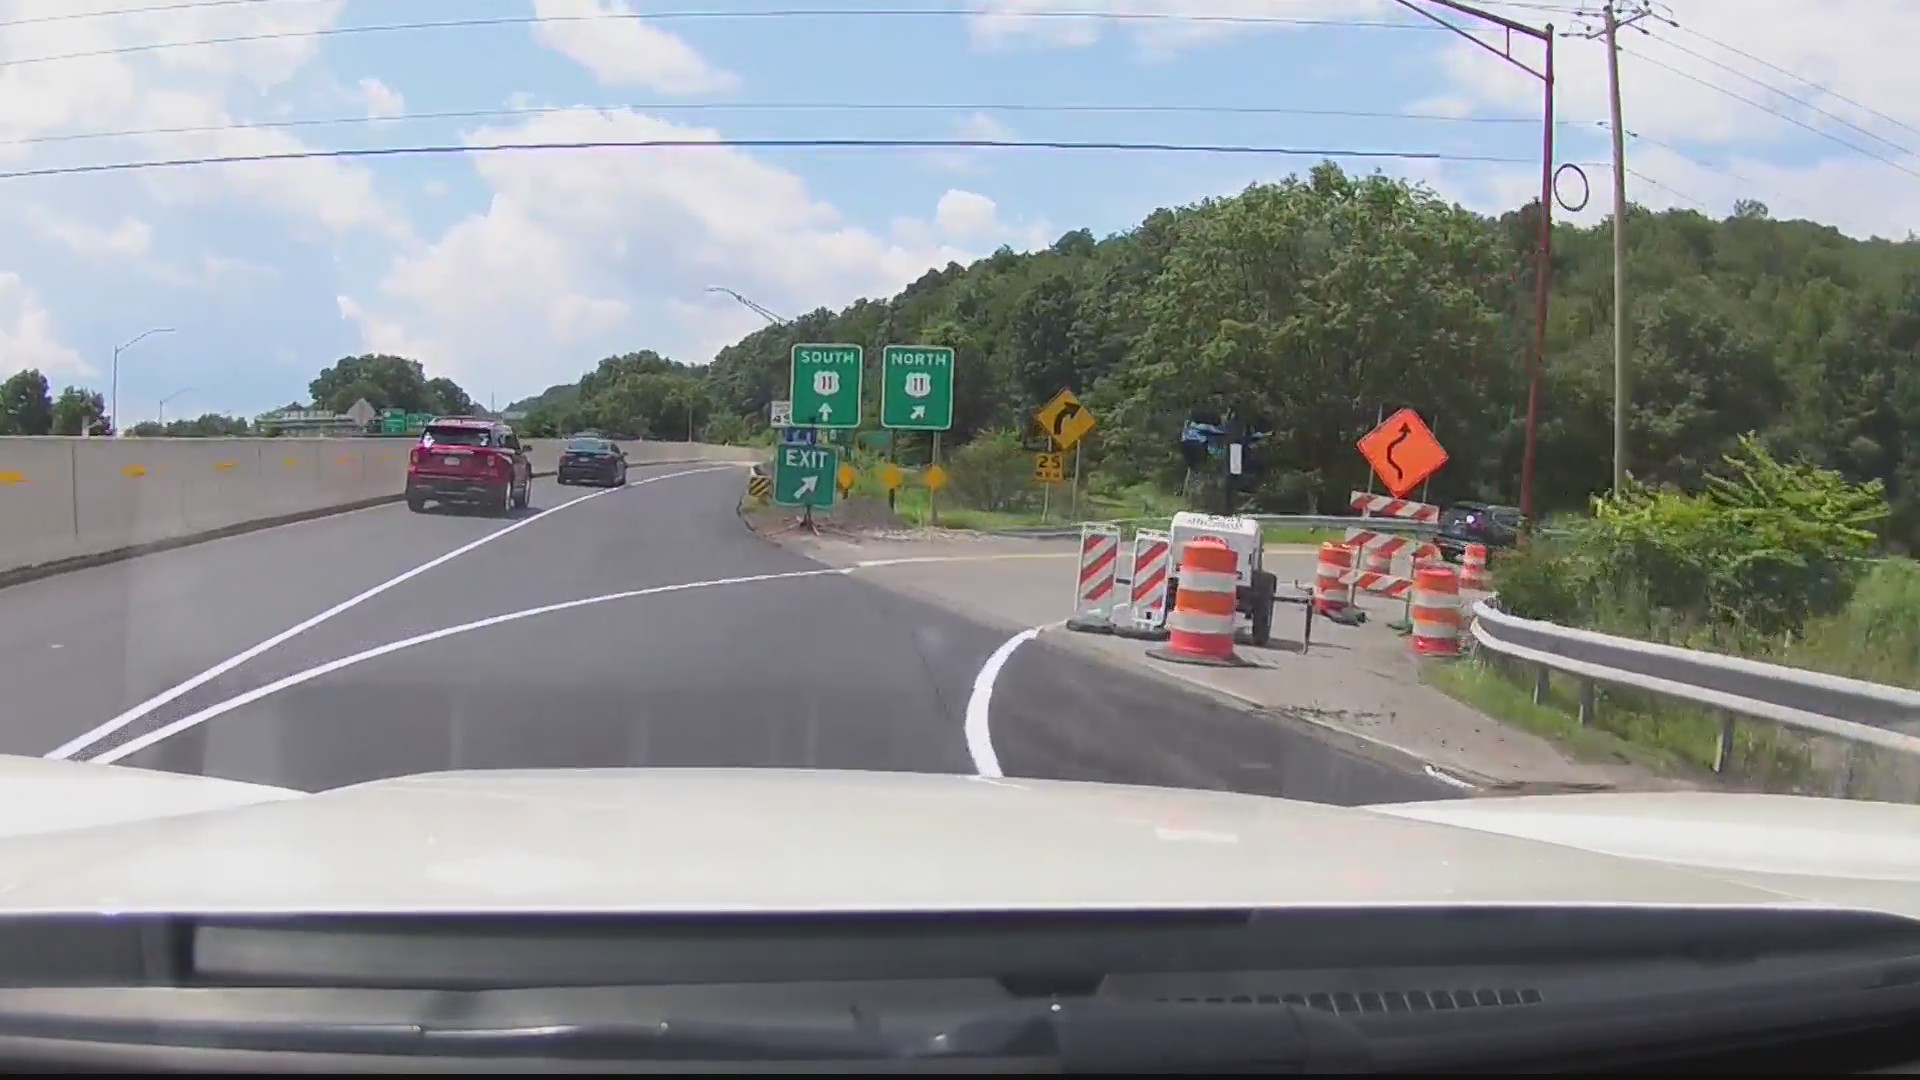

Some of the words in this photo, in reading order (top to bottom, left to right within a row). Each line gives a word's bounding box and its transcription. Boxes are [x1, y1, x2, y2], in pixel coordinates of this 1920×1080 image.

[801, 351, 854, 364] SOUTH
[891, 353, 947, 366] NORTH
[821, 376, 832, 390] 11
[913, 377, 924, 391] 11
[786, 449, 828, 468] EXIT
[1038, 455, 1061, 469] 25
